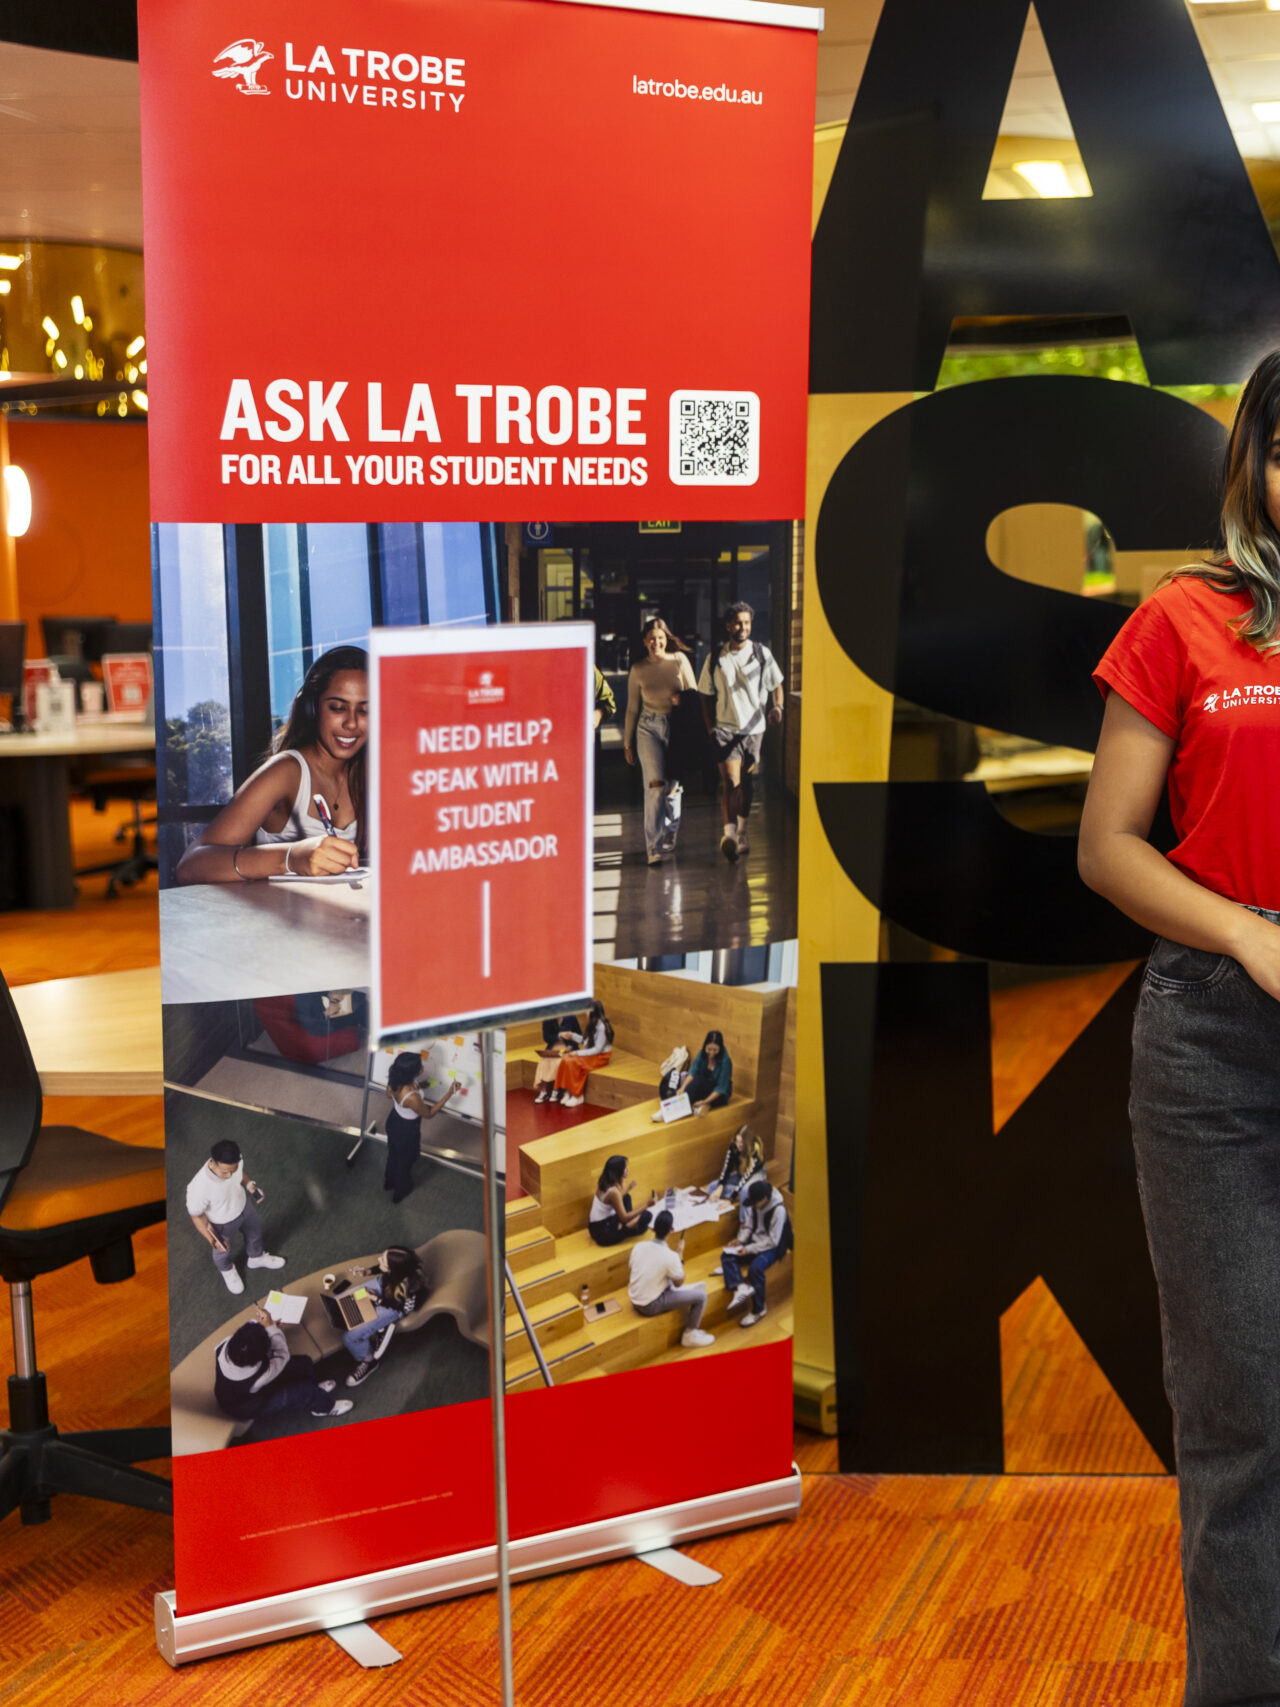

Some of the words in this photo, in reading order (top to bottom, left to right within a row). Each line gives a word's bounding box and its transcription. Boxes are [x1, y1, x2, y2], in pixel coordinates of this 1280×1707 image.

[285, 42, 335, 75] LA
[341, 48, 466, 87] TROBE
[286, 78, 465, 113] UNIVERSITY
[633, 75, 763, 105] latrobe.edu.au
[220, 379, 350, 442] ASK
[367, 382, 441, 443] LA
[455, 384, 647, 445] TROBE
[222, 454, 281, 485] FOR
[287, 455, 340, 485] ALL
[345, 455, 425, 486] YOUR
[430, 455, 557, 486] STUDENT
[563, 456, 648, 486] NEEDS
[1223, 687, 1241, 700] LA
[418, 724, 481, 754] NEED
[486, 718, 553, 749] HELP?
[411, 765, 479, 796] SPEAK
[483, 761, 538, 788] WITH
[543, 759, 559, 782] A
[437, 798, 535, 832] STUDENT
[410, 834, 559, 874] AMBASSADOR
